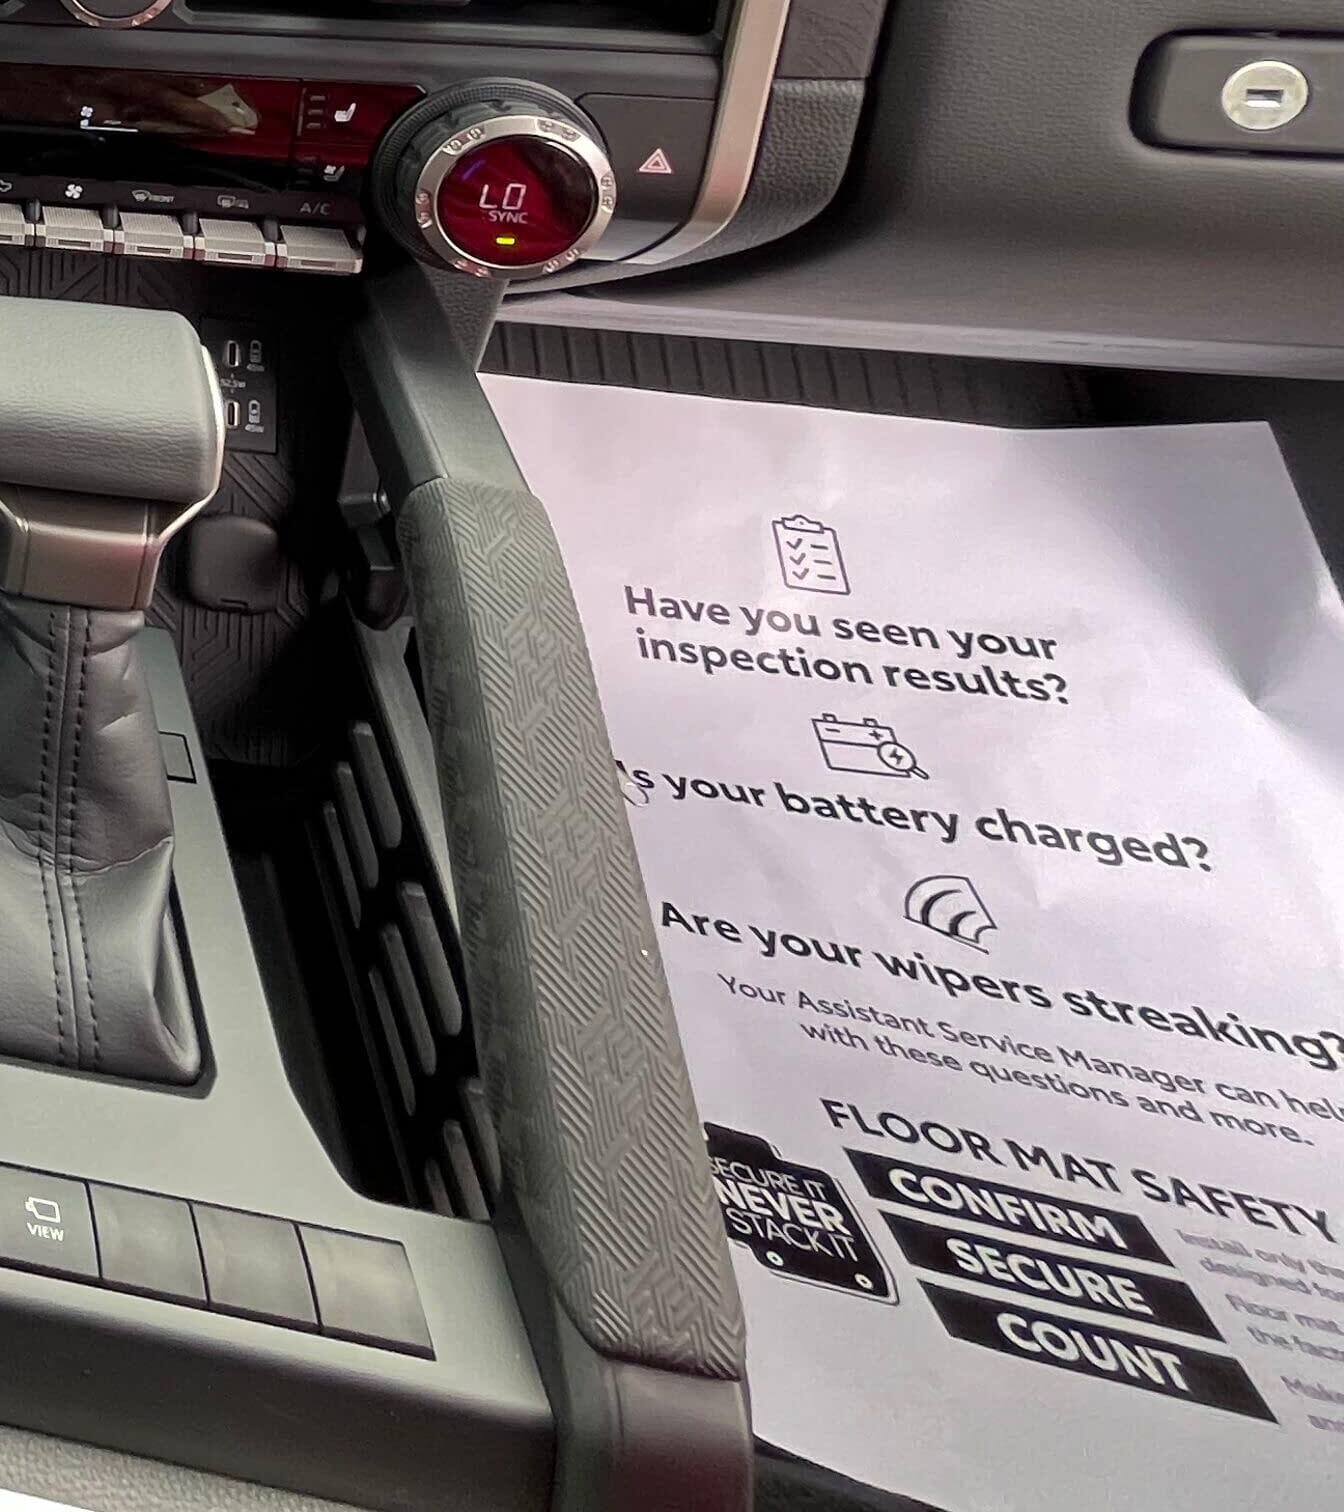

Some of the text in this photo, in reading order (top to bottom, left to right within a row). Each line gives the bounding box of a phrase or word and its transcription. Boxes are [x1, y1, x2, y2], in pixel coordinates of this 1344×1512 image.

[300, 202, 331, 216] A/C
[478, 183, 527, 210] LO
[488, 211, 529, 225] SYNC
[625, 585, 1058, 660] Have you seen your
[635, 627, 1070, 705] inspection results?
[662, 772, 768, 807] your
[775, 781, 960, 844] battery
[975, 808, 1214, 873] charged?
[660, 900, 742, 944] Are
[749, 923, 863, 968] your
[873, 949, 1053, 1011] wipers
[717, 972, 788, 1006] Your
[797, 990, 936, 1039] Assistant
[938, 1020, 1056, 1064] Service
[1056, 1045, 1207, 1094] Manager
[1215, 1083, 1281, 1110] can
[800, 1022, 1314, 1146] with these questions and more.
[712, 1175, 854, 1237] NEVER
[802, 1179, 826, 1201] IT
[820, 1097, 1338, 1245] FLOOR MAT SAFETY
[888, 1167, 1129, 1250] CONFIRM
[26, 1222, 64, 1242] VIEW
[726, 1207, 858, 1262] STACK IT
[946, 1239, 1154, 1316] SECURE
[996, 1312, 1192, 1393] COUNT
